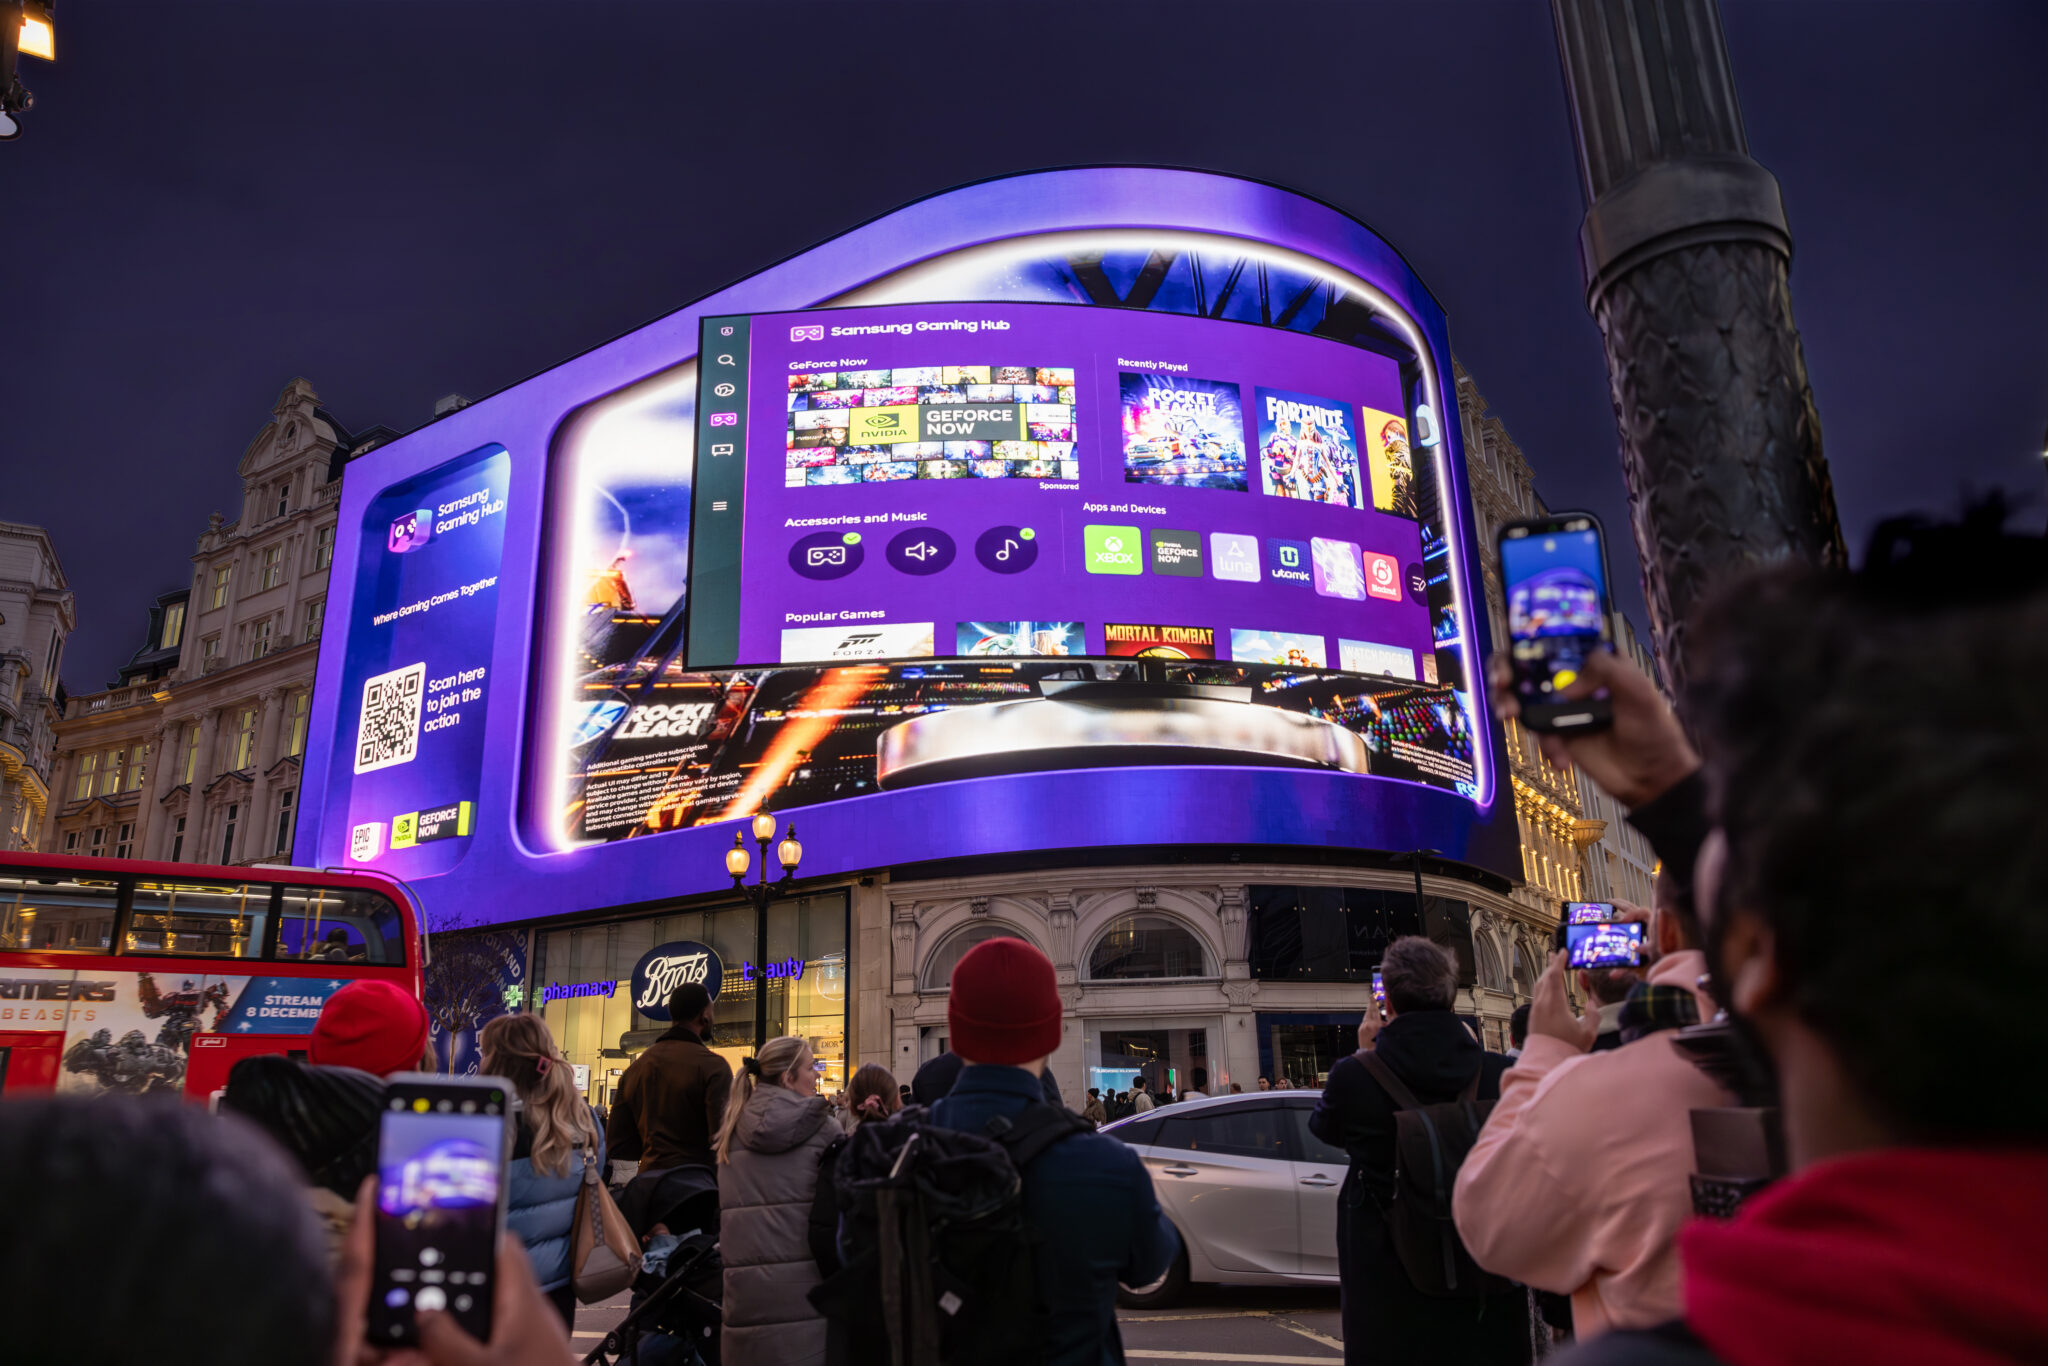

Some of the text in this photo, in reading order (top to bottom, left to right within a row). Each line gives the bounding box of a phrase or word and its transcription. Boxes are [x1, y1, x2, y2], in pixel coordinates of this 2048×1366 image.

[831, 319, 1010, 337] Samsung Gaming Hub
[789, 357, 868, 370] GeForce Now
[1118, 358, 1188, 372] Recently Played
[1149, 388, 1215, 405] ROCKET
[926, 409, 1012, 422] GEFORCE
[1154, 400, 1216, 418] LEAGUE
[1266, 396, 1344, 428] FORTNITE
[927, 422, 974, 435] NOW
[1040, 482, 1080, 490] Sponsored
[438, 488, 490, 517] Samsung
[1084, 502, 1166, 515] Apps and Devices
[436, 500, 504, 534] Gaming Hub
[785, 512, 927, 527] Accessories and Music
[1095, 552, 1134, 564] XBOX
[1158, 548, 1198, 558] GEFORCE
[1158, 555, 1180, 564] NOW
[1220, 556, 1254, 573] luna
[373, 576, 498, 626] Where Gaming Comes Together
[785, 609, 885, 623] Popular Games
[1105, 624, 1214, 646] MORTAL KOMBAT
[428, 667, 486, 693] Scan here
[426, 687, 482, 714] to join the
[424, 712, 460, 732] action
[586, 744, 708, 770] Additional gaming service subscription
[636, 758, 667, 768] controller
[586, 782, 608, 790] Actual
[616, 778, 630, 786] may
[586, 788, 609, 798] subject
[618, 782, 642, 792] change
[642, 778, 666, 788] without
[586, 794, 616, 804] Available
[616, 790, 638, 800] games
[652, 784, 678, 792] services
[680, 780, 694, 788] may
[694, 777, 709, 785] vary
[586, 802, 608, 811] service
[639, 792, 666, 802] network
[717, 780, 738, 788] device
[420, 808, 458, 826] GEFORCE
[586, 816, 612, 825] Internet
[612, 808, 648, 819] connection
[695, 796, 720, 806] gaming
[586, 810, 598, 818] and
[599, 808, 614, 816] may
[614, 804, 638, 813] change
[418, 824, 440, 838] NOW
[586, 820, 625, 832] subscription
[354, 827, 370, 844] EPIC
[500, 947, 520, 978] AND
[743, 957, 804, 980] bauty
[637, 952, 708, 1008] Boots
[264, 995, 322, 1006] STREAM
[543, 980, 617, 1004] pharmacy
[2, 1008, 96, 1022] BEASTS
[246, 1006, 324, 1018] 8 DECEMB
